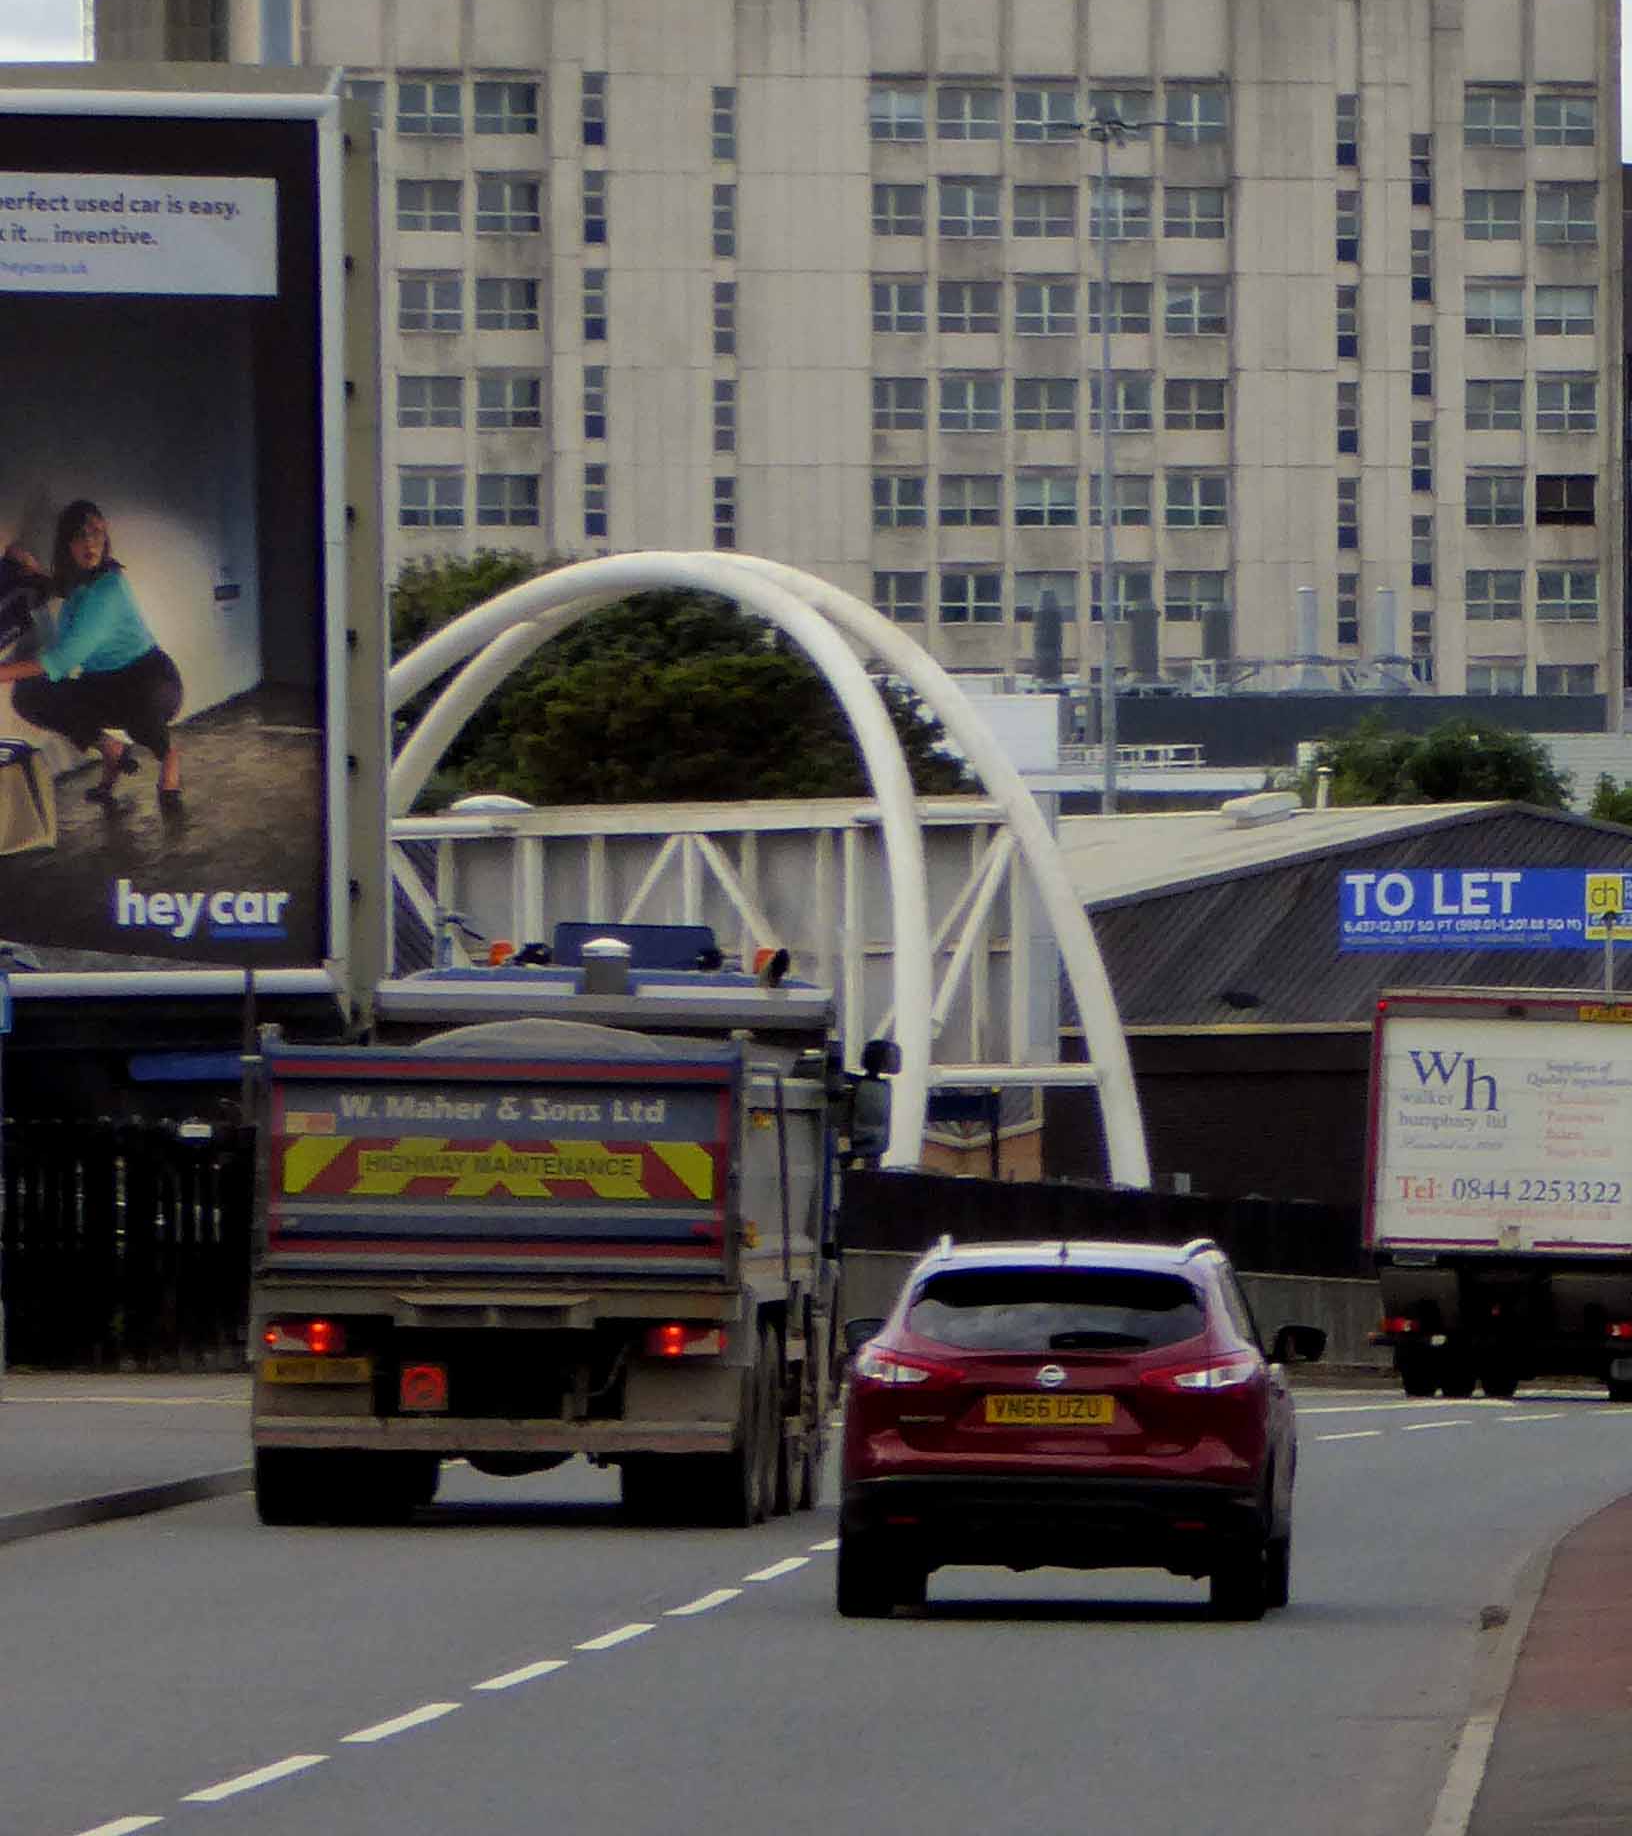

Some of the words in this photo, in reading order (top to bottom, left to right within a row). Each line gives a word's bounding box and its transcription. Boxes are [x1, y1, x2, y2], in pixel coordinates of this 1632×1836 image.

[0, 191, 68, 214] erfect
[74, 193, 125, 213] used
[129, 198, 161, 214] car
[167, 195, 183, 214] is
[188, 200, 240, 221] easy.
[53, 224, 158, 245] inventive.
[1345, 872, 1415, 916] TO
[1433, 871, 1521, 915] LET
[340, 1094, 377, 1118] W.
[384, 1095, 487, 1121] Maher
[496, 1096, 522, 1121] &
[529, 1097, 602, 1124] Sons
[612, 1099, 667, 1124] Ltd
[364, 1153, 466, 1174] HIGHWAY
[473, 1154, 635, 1177] MAINTENANCE
[1397, 1176, 1442, 1200] Tel:
[1451, 1177, 1511, 1202] 0844
[1517, 1179, 1623, 1205] 2253322
